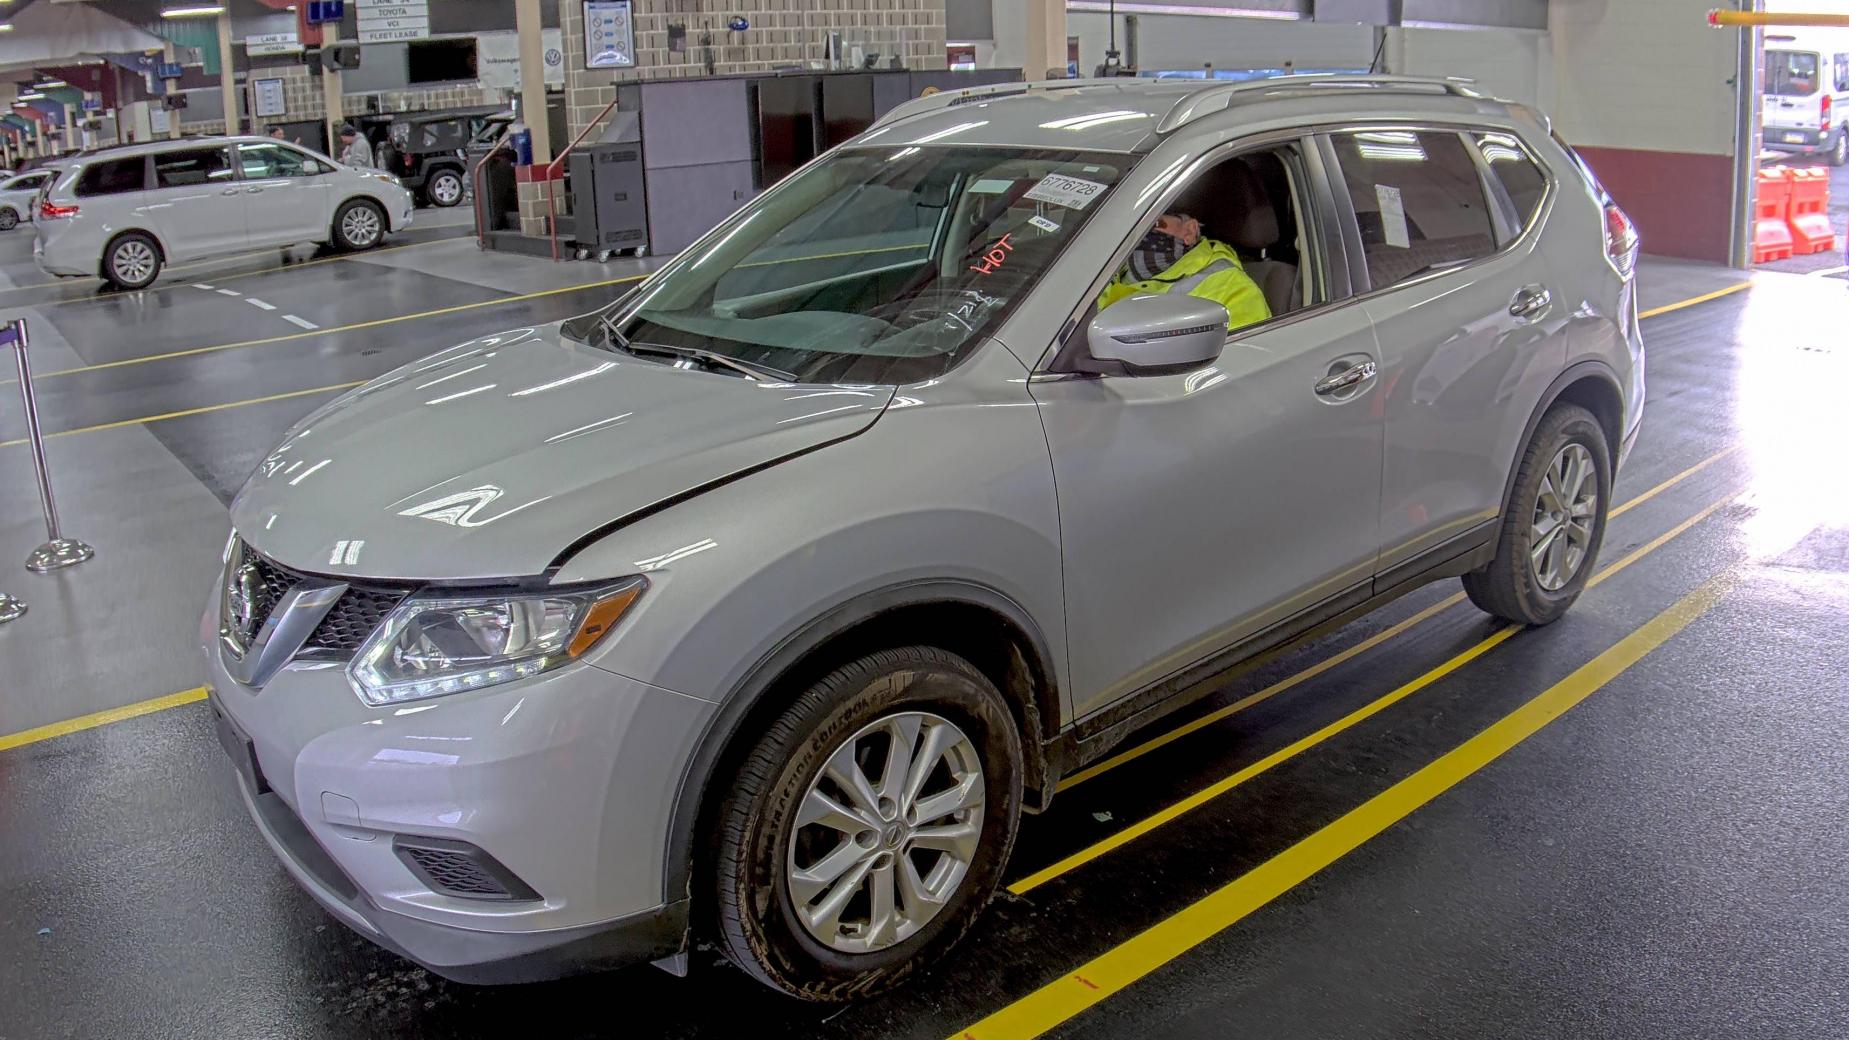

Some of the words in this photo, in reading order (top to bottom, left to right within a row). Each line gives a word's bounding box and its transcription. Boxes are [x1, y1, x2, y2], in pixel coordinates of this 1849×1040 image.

[378, 8, 407, 16] TOYOTA
[369, 32, 392, 40] FLEET
[1040, 176, 1098, 196] 6776728
